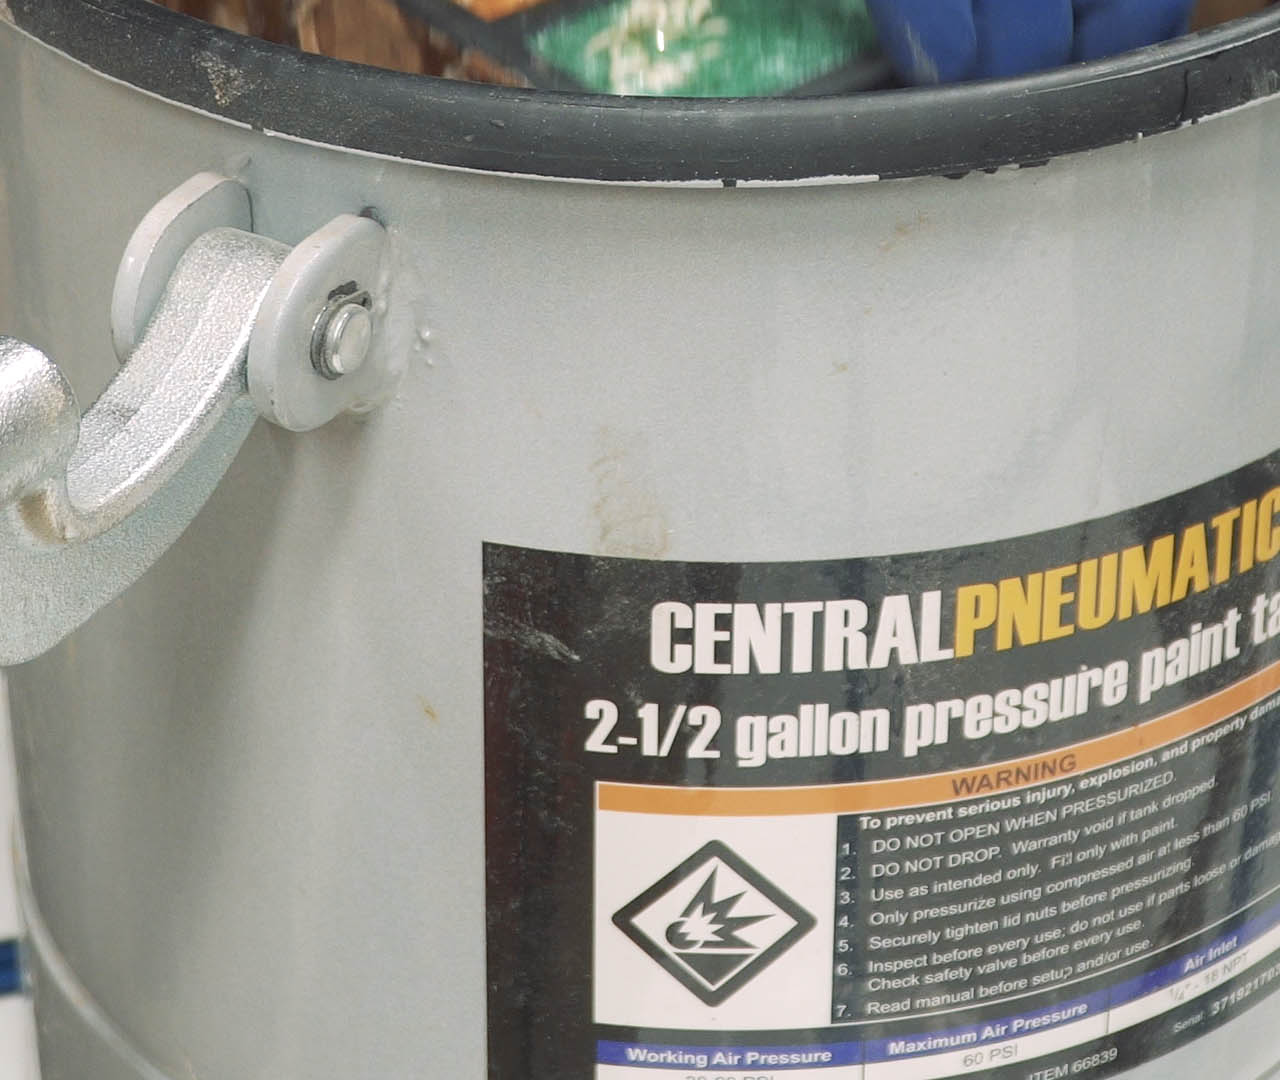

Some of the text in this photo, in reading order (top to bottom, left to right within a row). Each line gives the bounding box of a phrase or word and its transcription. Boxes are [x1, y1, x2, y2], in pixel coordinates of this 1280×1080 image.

[584, 699, 721, 759] 2-1/2
[736, 703, 890, 768] gallon
[904, 659, 1129, 759] pressure
[1138, 608, 1242, 705] paint
[842, 770, 1176, 855] 1. DO NOT OPEN WHEN PRESSURIZED.
[860, 816, 881, 831] To
[886, 807, 953, 830] prevent
[958, 792, 1020, 818] serious
[1026, 783, 1076, 807] injury,
[1080, 755, 1158, 791] explosion,
[1161, 741, 1188, 762] and
[1191, 717, 1247, 752] property
[952, 753, 1077, 797] WARNING
[839, 916, 854, 928] 4.
[871, 910, 908, 927] Only
[913, 896, 996, 921] pressurize
[1001, 886, 1041, 905] using
[1045, 857, 1134, 894] compressed
[1137, 850, 1155, 864] air
[1158, 843, 1170, 857] at
[1174, 830, 1200, 850] less
[1202, 817, 1230, 839] than
[1232, 805, 1248, 822] 60
[840, 775, 1217, 880] 2. DO NOT DROP. Warranty void if tank dropped.
[840, 892, 855, 905] 3.
[871, 888, 904, 901] Use
[909, 885, 929, 897] as
[933, 872, 1002, 894] intended
[1007, 862, 1041, 882] only.
[1076, 844, 1107, 861] only
[1110, 833, 1138, 851] with
[1141, 817, 1178, 844] paint.
[837, 964, 852, 976] 6.
[869, 955, 928, 976] Inspect
[933, 947, 982, 965] before
[987, 938, 1031, 956] every
[1070, 920, 1088, 934] do
[1092, 910, 1115, 925] not
[1118, 901, 1143, 918] use
[1147, 893, 1156, 907] if
[1158, 881, 1191, 907] parts
[1193, 864, 1226, 887] loose
[1228, 856, 1242, 870] or
[838, 857, 1194, 953] 5. Securely tighten lid nuts before pressurizing.
[836, 1006, 851, 1018] 7.
[866, 999, 911, 1015] Read
[916, 988, 974, 1008] manual
[979, 977, 1028, 997] before
[1077, 949, 1122, 973] and/or
[1125, 938, 1152, 956] use.
[869, 920, 1144, 991] Check safety valve before every use.
[1184, 936, 1237, 973] Air Inlet
[1223, 952, 1248, 973] NPT
[627, 1048, 833, 1067] Working Air Pressure
[888, 1003, 1088, 1055] Maximum Air Pressure
[963, 1044, 1018, 1067] 60 PSI
[1028, 1047, 1118, 1080] ITEM 66839
